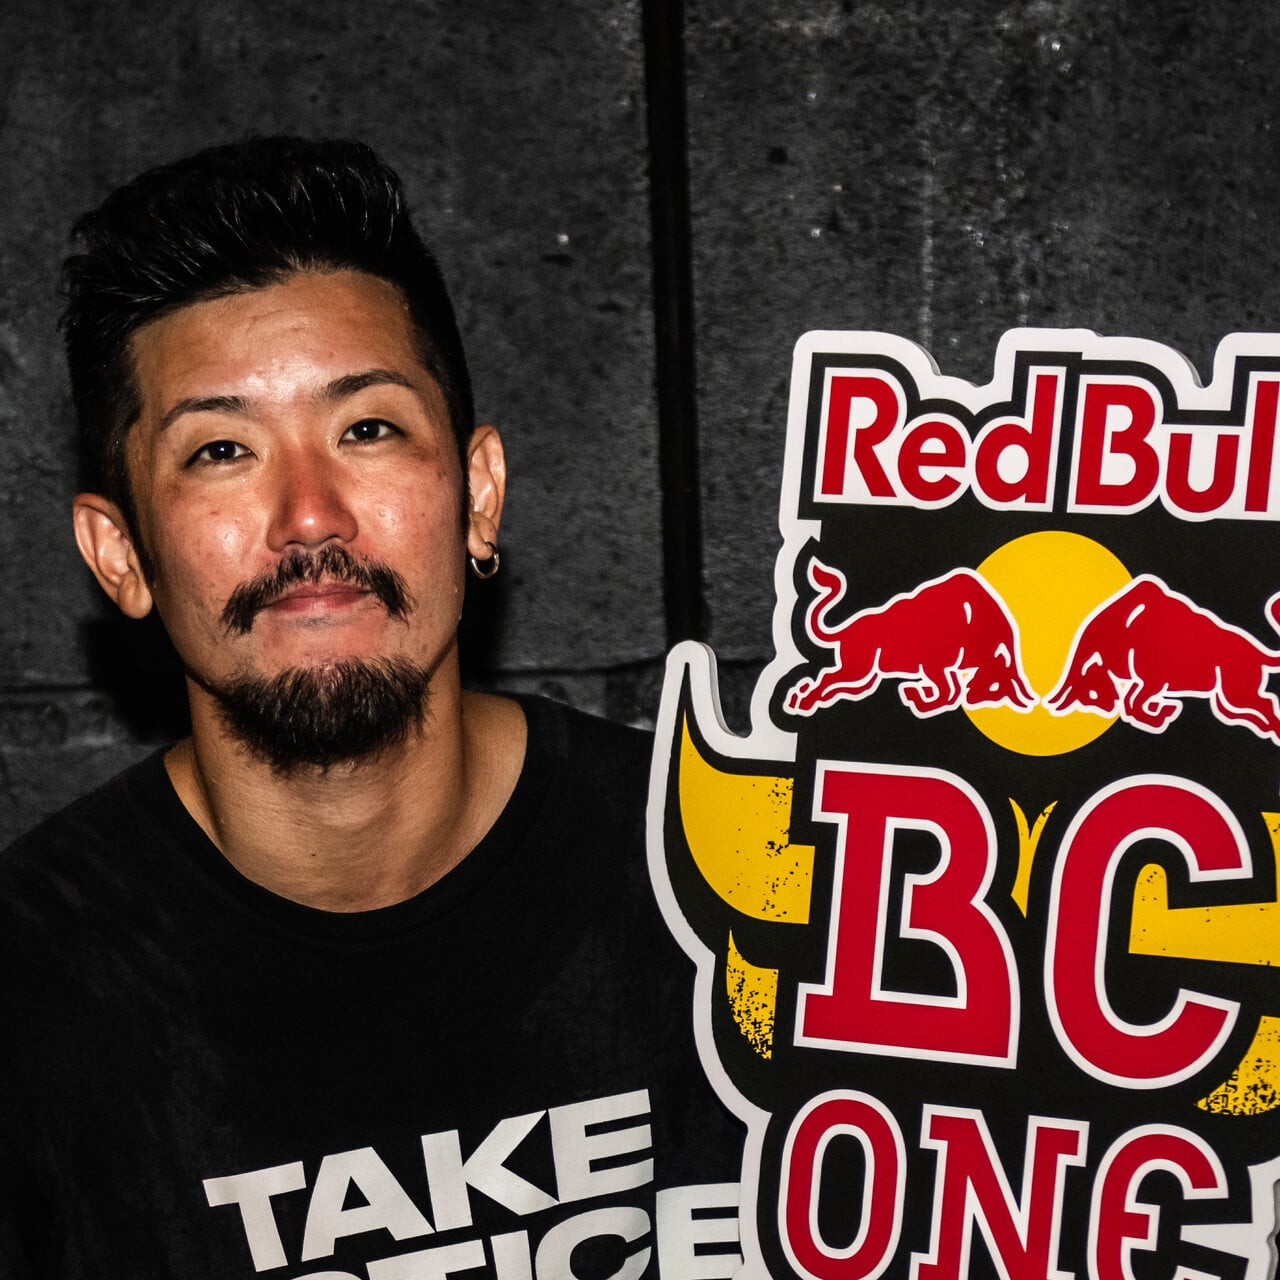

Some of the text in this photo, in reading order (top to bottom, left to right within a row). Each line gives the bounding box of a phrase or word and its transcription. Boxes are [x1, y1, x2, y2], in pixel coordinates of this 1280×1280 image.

[818, 371, 1061, 508] Red
[796, 764, 1250, 1086] BC
[201, 1088, 655, 1273] TAKE
